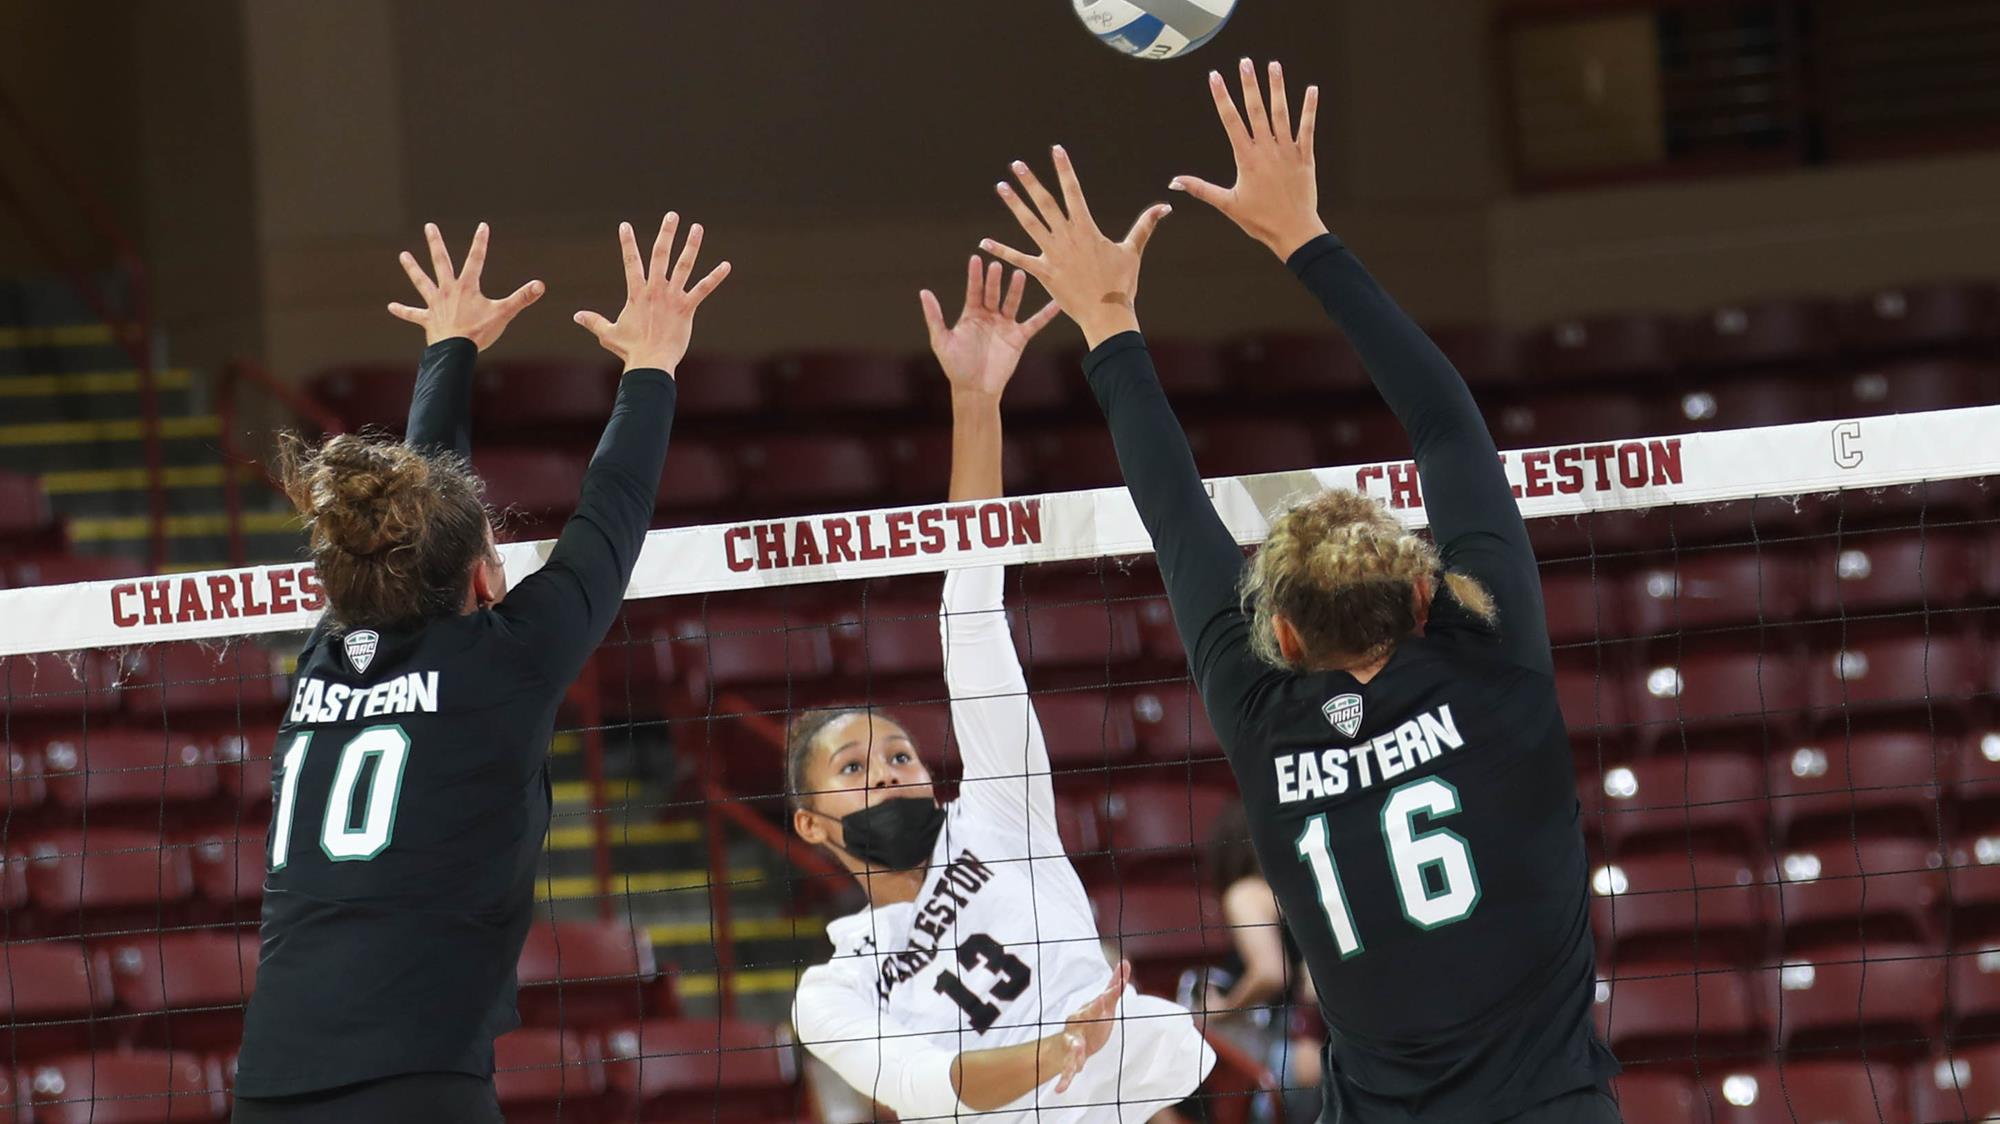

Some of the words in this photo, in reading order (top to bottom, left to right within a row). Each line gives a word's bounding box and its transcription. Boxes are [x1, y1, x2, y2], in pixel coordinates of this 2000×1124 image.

[1832, 422, 1863, 469] C
[725, 499, 1041, 573] CHARLESTON
[290, 671, 439, 723] EASTERN
[272, 724, 412, 871] 10
[1275, 704, 1464, 803] EASTERN
[1296, 775, 1482, 960] 16
[933, 933, 1031, 1036] 13
